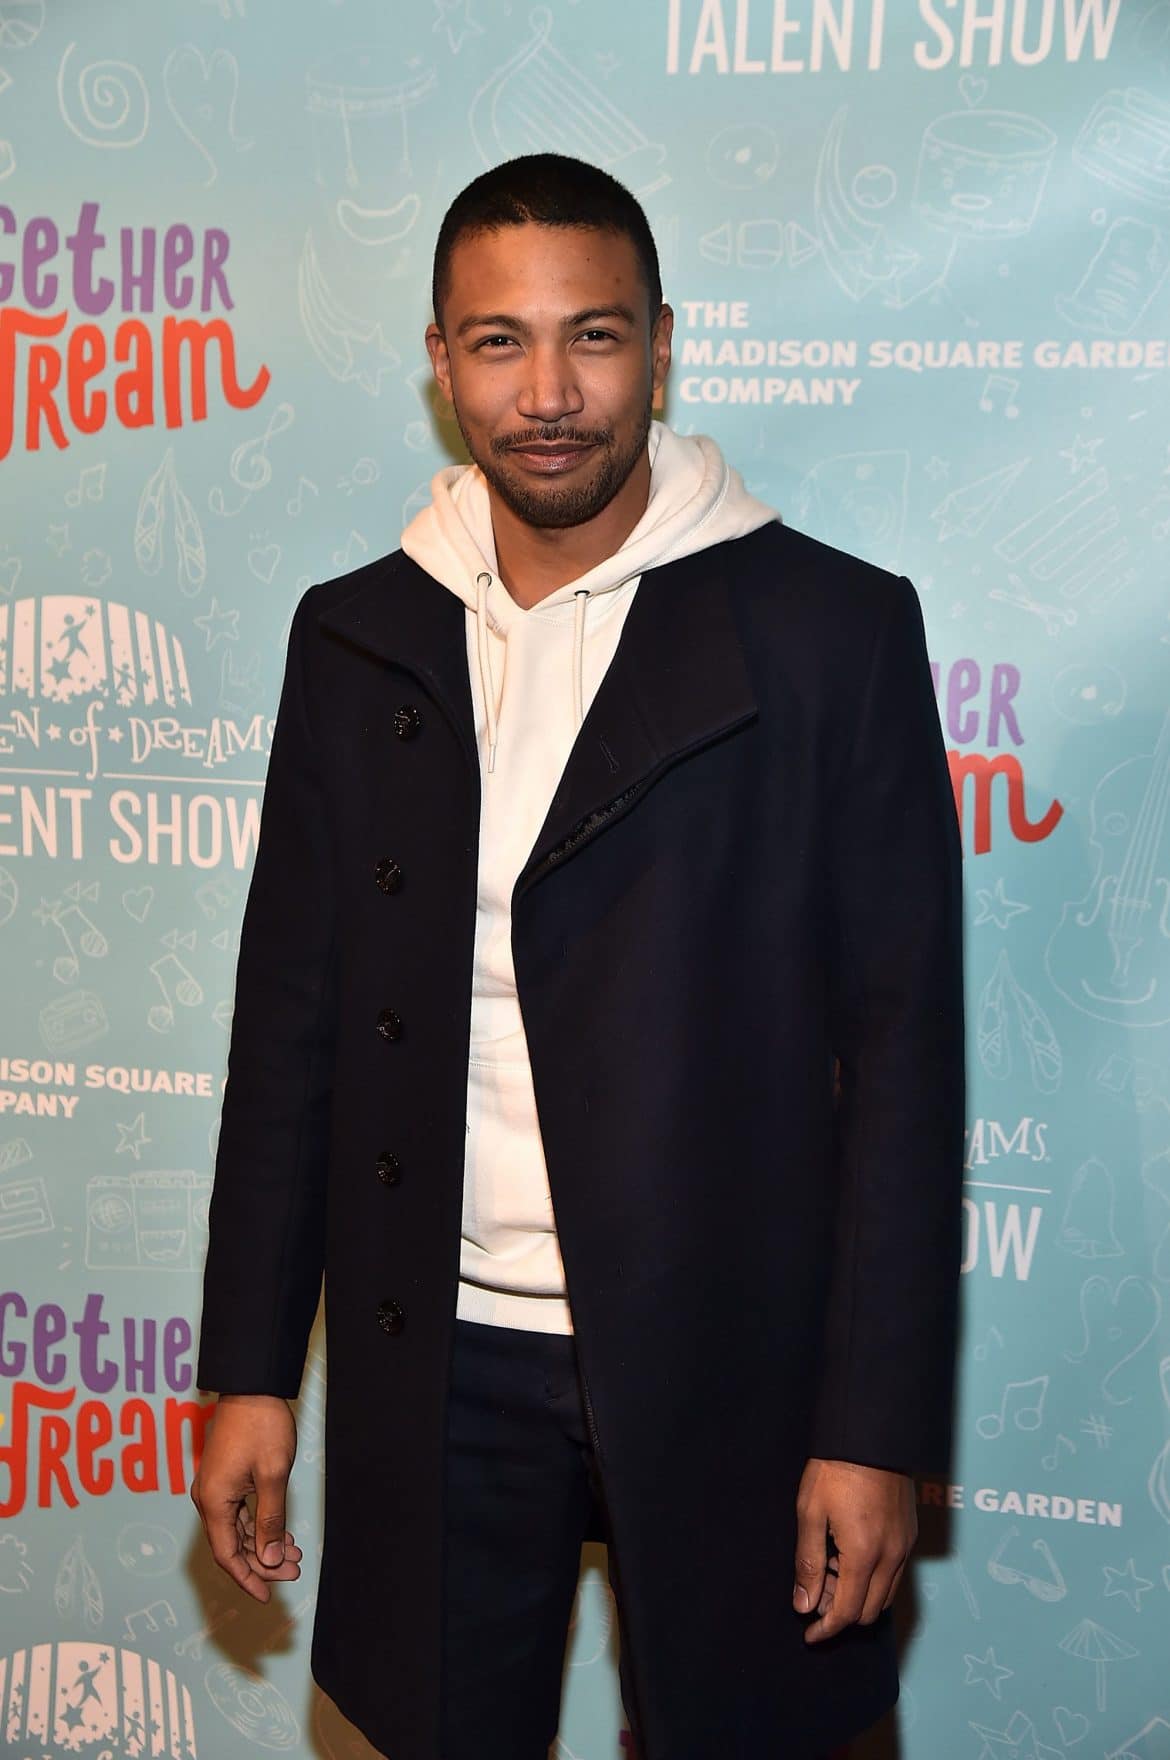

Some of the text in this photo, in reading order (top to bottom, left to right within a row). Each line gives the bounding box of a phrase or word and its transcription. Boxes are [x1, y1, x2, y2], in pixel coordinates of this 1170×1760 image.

[682, 301, 749, 329] THE
[681, 339, 1170, 372] MADISON SQUARE GARDE
[679, 377, 861, 405] COMPANY
[69, 701, 104, 780] of
[109, 790, 262, 870] SHOW
[0, 1057, 75, 1087] ISON
[85, 1064, 213, 1097] SQUARE
[0, 1090, 80, 1118] PANY
[964, 1117, 1049, 1170] AMS
[974, 1488, 1122, 1527] GARDEN
